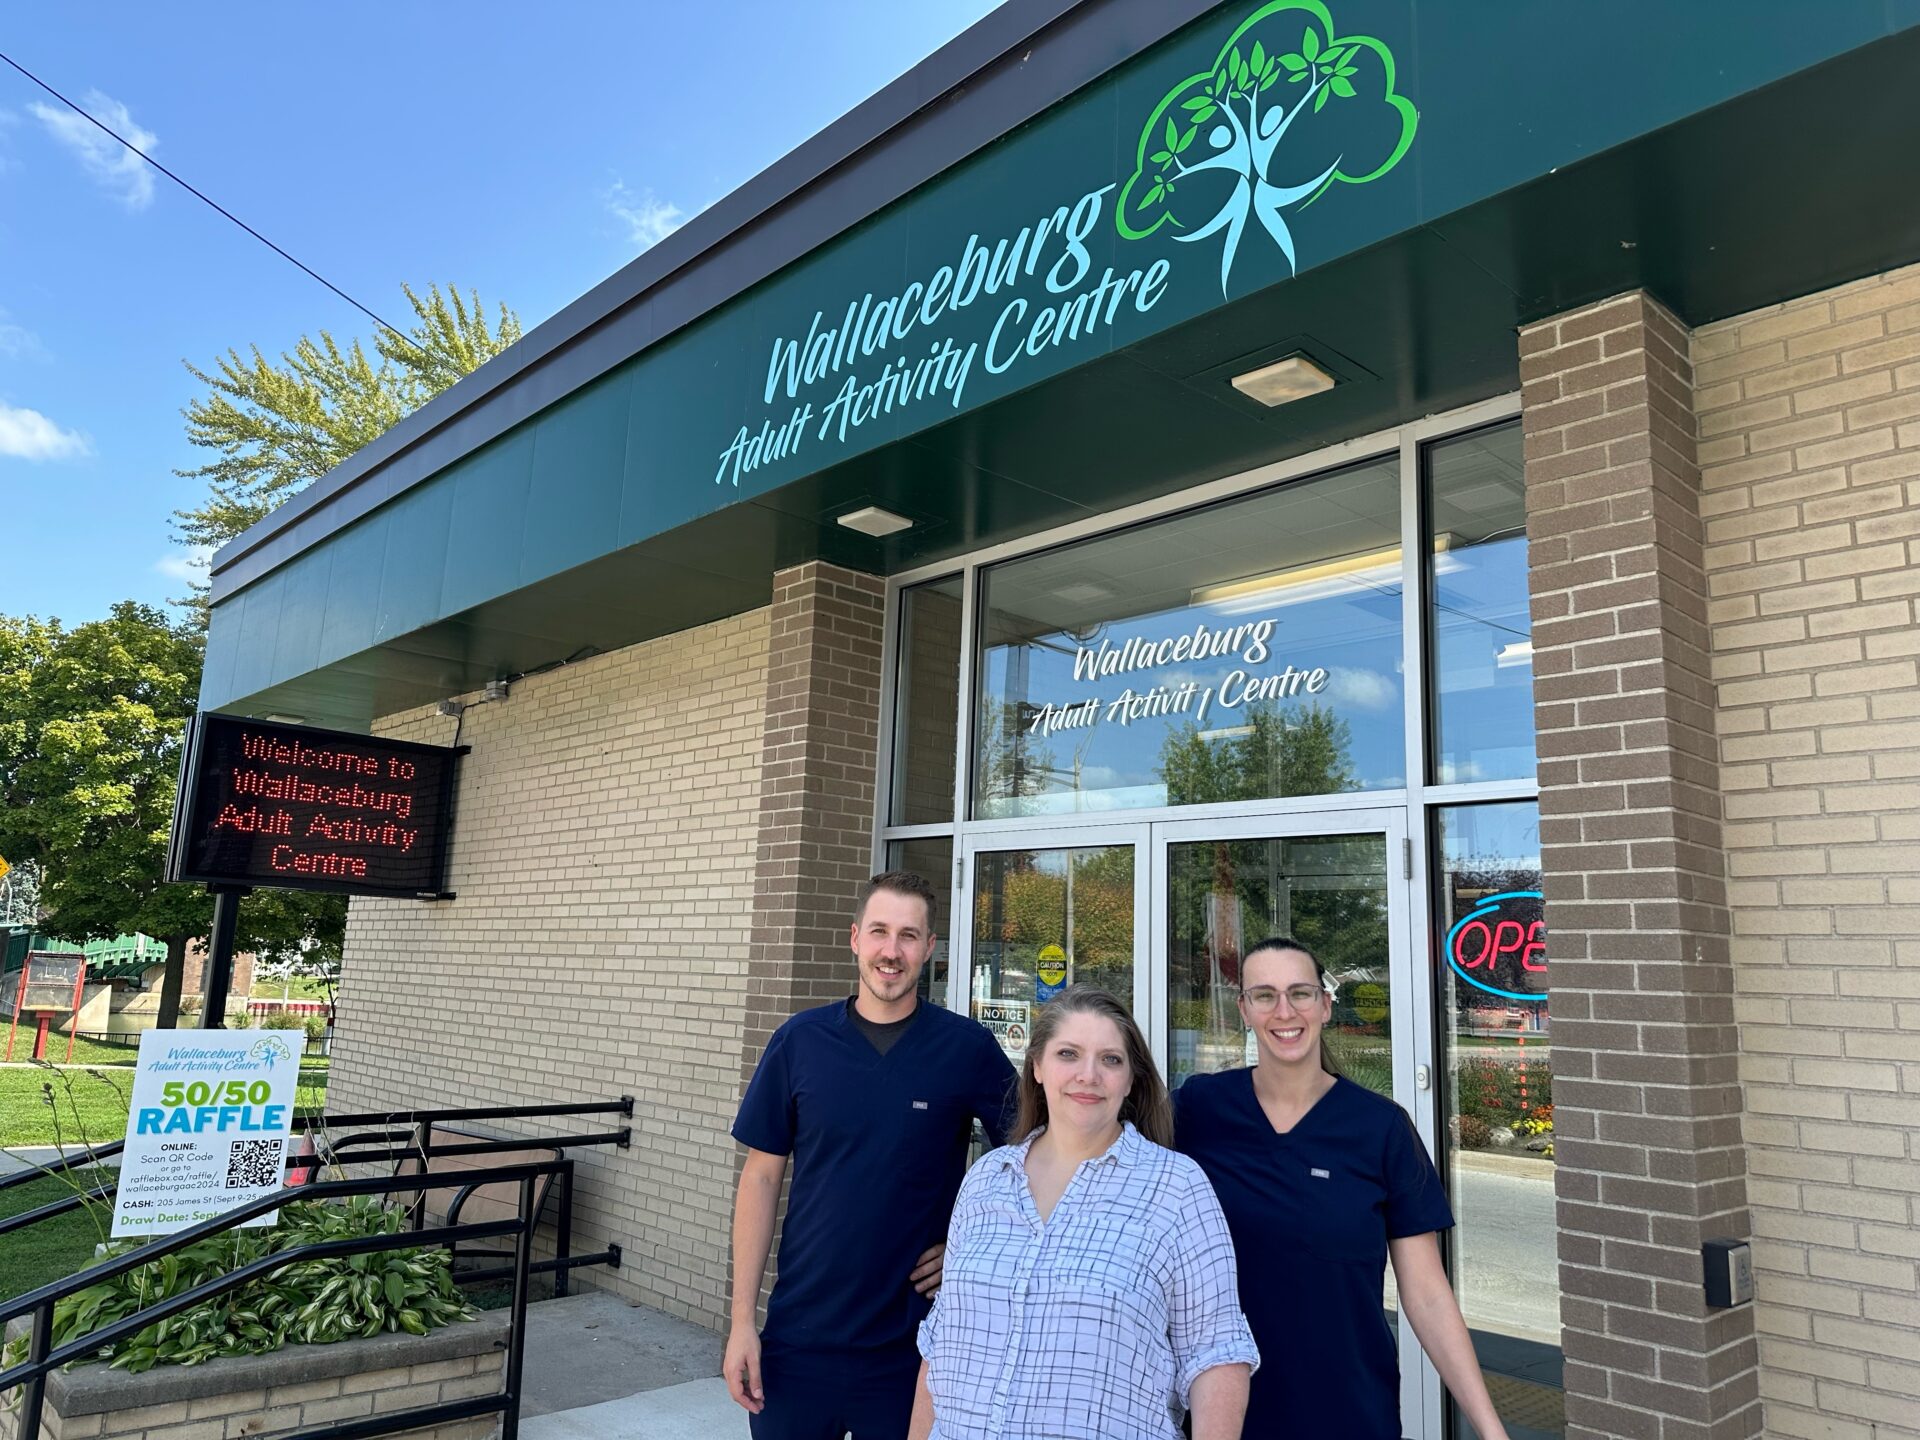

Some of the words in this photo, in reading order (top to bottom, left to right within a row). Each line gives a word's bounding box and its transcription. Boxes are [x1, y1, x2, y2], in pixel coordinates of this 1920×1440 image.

[763, 182, 1116, 404] Wallaceburg
[714, 402, 813, 487] Adult
[818, 337, 978, 442] Activity
[984, 259, 1170, 374] Centre
[1073, 618, 1280, 681] Wallaceburg
[1030, 697, 1101, 737] Adult
[1218, 665, 1327, 708] Centre
[242, 733, 379, 776] Welcome
[388, 757, 416, 780] to
[234, 767, 412, 819] Wallaceburg
[214, 803, 293, 835] Adult
[305, 813, 418, 852] Activity
[271, 844, 367, 876] Centre
[1456, 921, 1547, 972] OPE
[1040, 962, 1064, 970] CAUTION
[983, 1008, 1024, 1020] NOTICE
[168, 1047, 247, 1062] Wallaceburg
[148, 1060, 179, 1072] Adult
[181, 1061, 223, 1073] Activity
[224, 1060, 260, 1071] Centre
[160, 1080, 271, 1107] 50/50
[136, 1104, 286, 1135] RAFFLE
[160, 1143, 198, 1151] ONLINE:
[140, 1154, 166, 1164] Scan
[168, 1153, 185, 1163] QR
[186, 1152, 214, 1162] Code
[130, 1171, 218, 1184] rafflebox.ca/raffle/
[170, 1166, 181, 1174] go
[125, 1180, 220, 1193] wallaceburgaac2024
[122, 1200, 154, 1209] CASH:
[157, 1199, 174, 1207] 205
[175, 1197, 201, 1206] James
[203, 1196, 212, 1204] St
[213, 1195, 236, 1205] (Sept
[237, 1193, 257, 1201] 9-25
[120, 1215, 154, 1226] Draw
[157, 1213, 189, 1224] Date:
